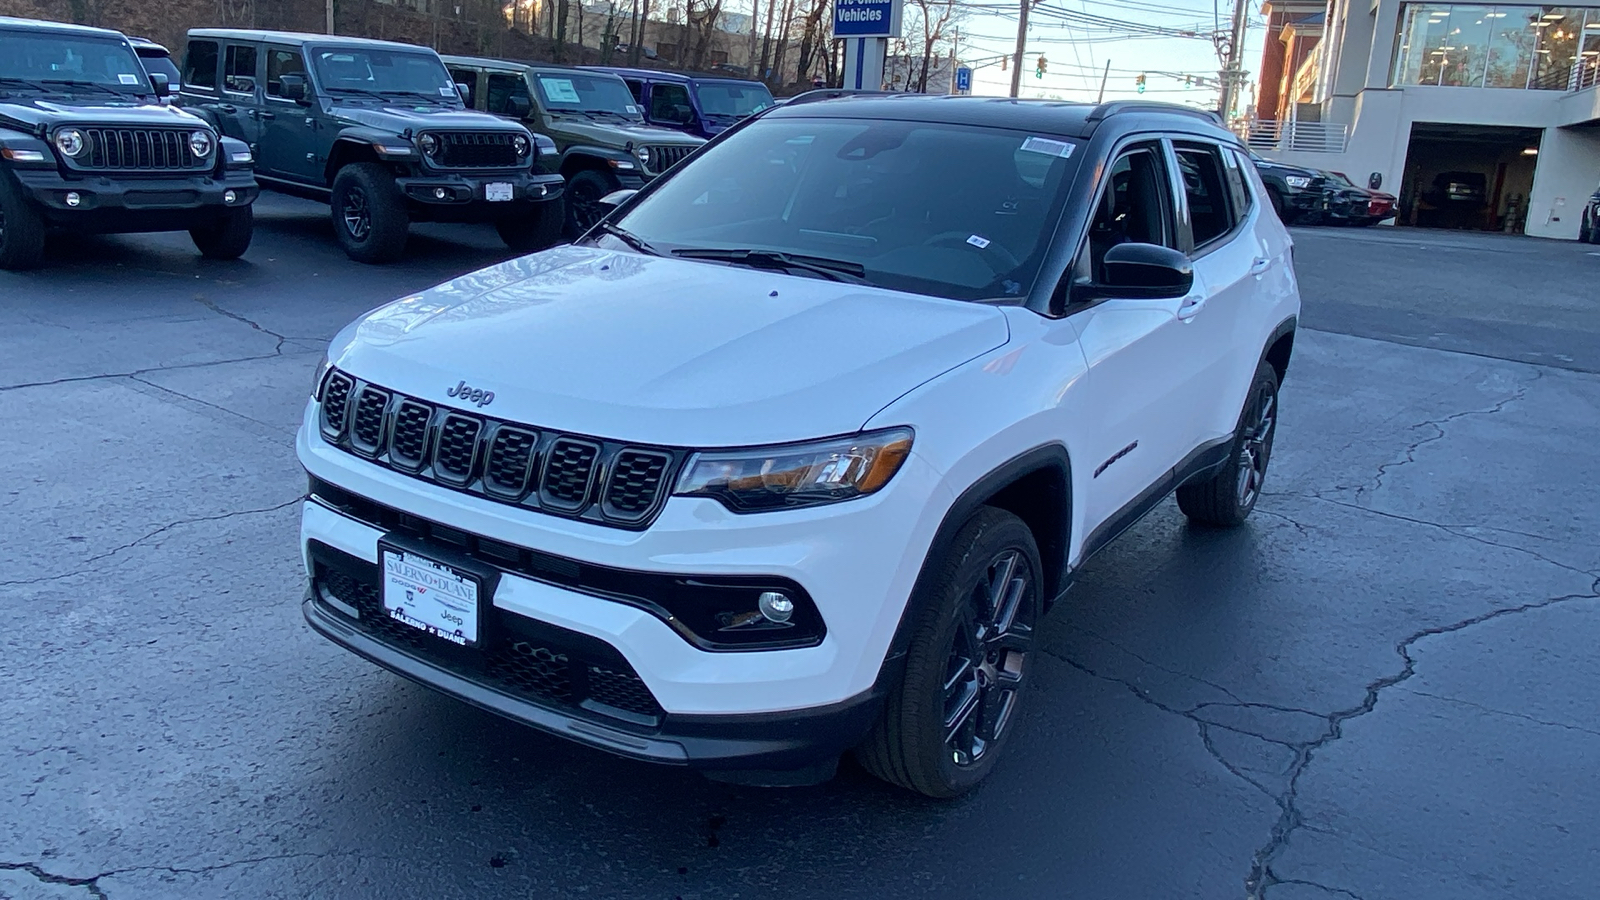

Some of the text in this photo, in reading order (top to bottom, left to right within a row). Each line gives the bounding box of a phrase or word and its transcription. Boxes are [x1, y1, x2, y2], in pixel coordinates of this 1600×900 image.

[838, 8, 882, 22] Vehicles
[959, 73, 968, 84] H
[447, 380, 495, 408] Jeep
[386, 559, 433, 585] SALERNO
[438, 577, 475, 601] DUANE
[390, 610, 466, 646] SALERNO DUANE
[440, 609, 464, 626] Jeep
